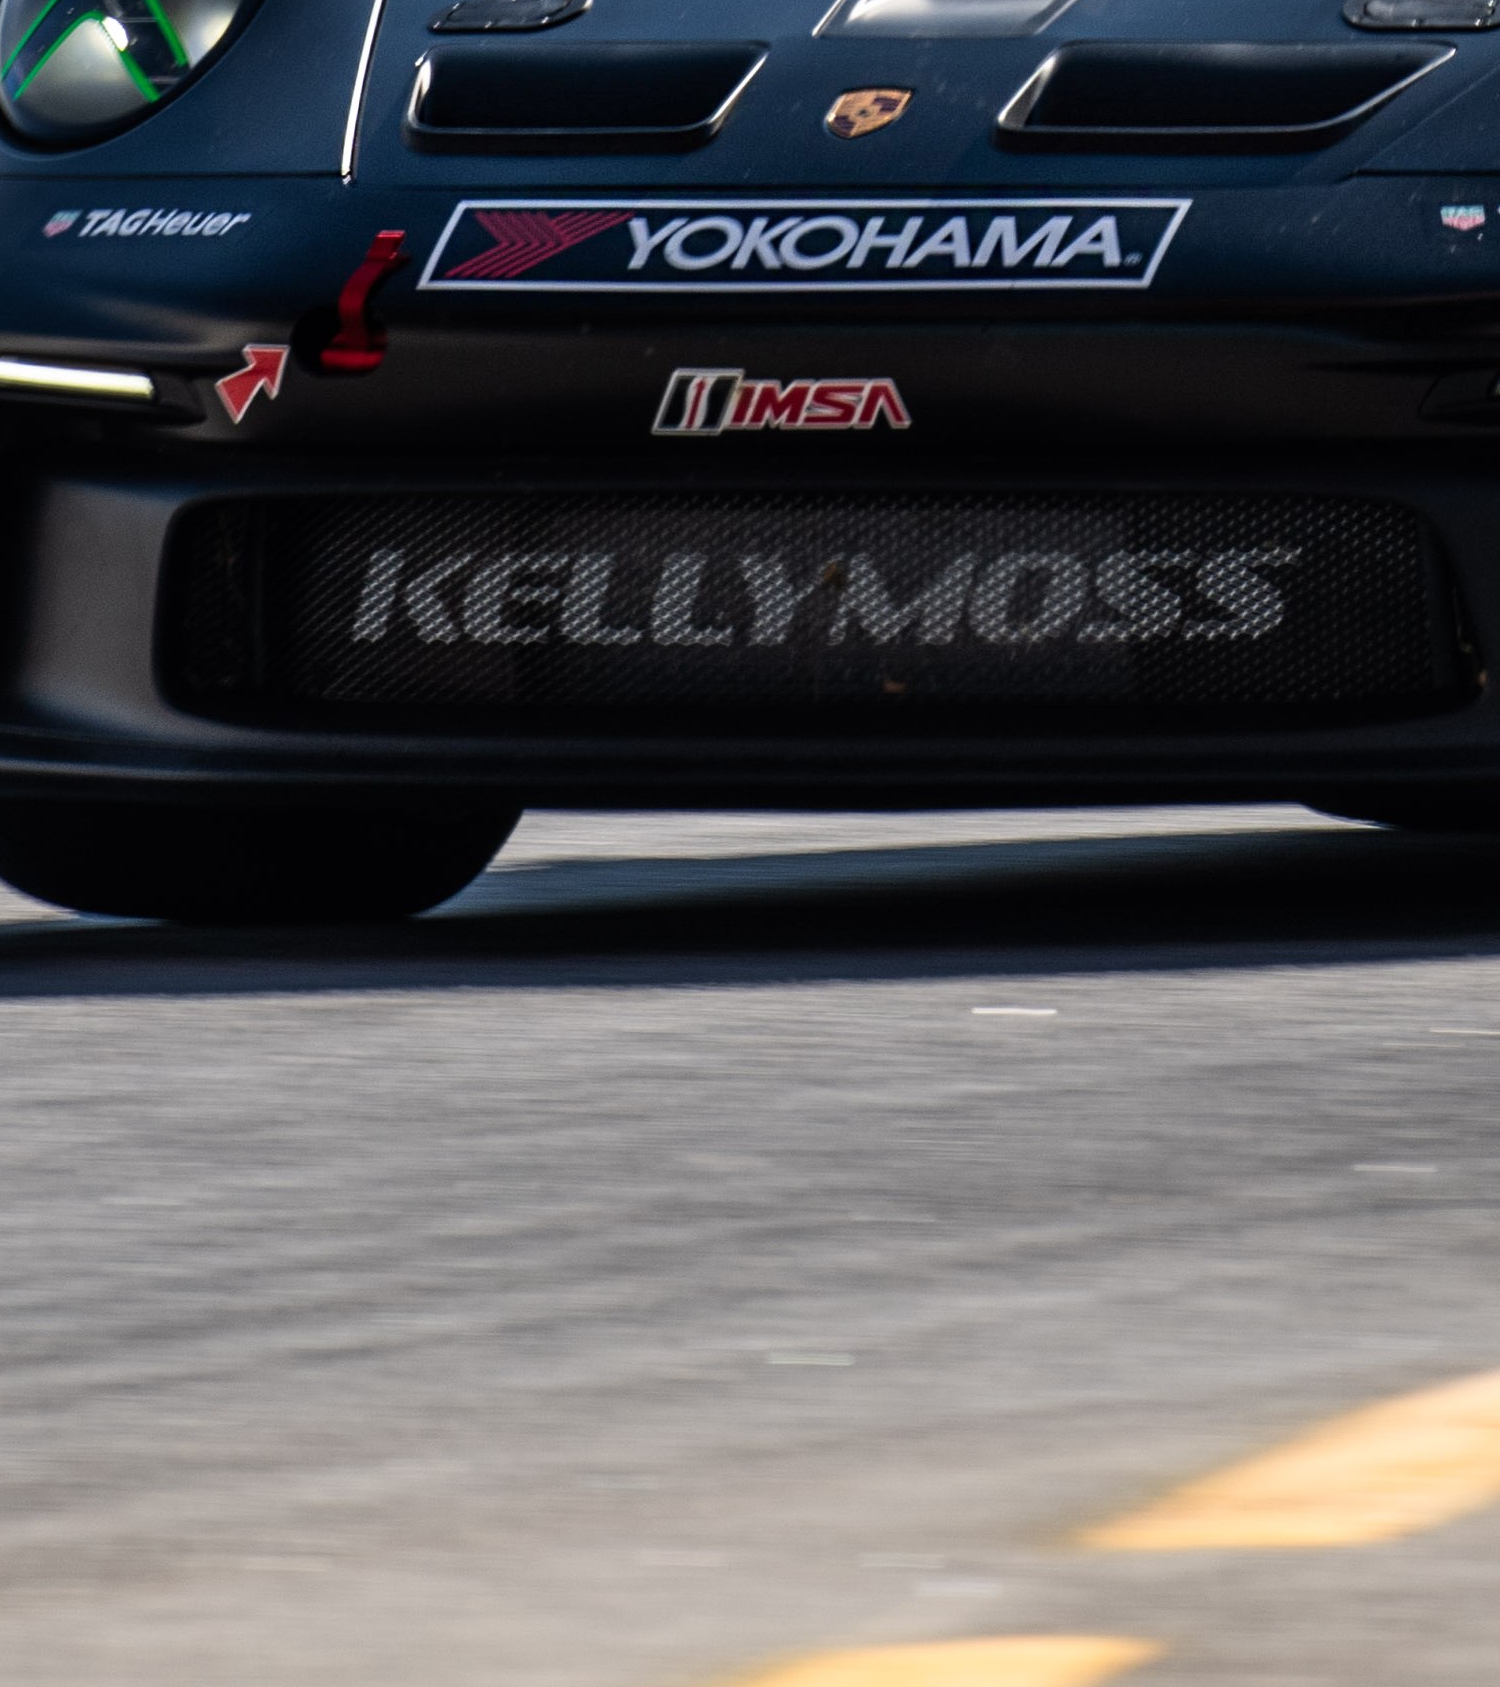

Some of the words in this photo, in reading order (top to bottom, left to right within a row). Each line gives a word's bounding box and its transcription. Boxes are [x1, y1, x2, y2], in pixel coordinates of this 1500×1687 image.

[626, 214, 1123, 269] YOKOHAMA
[728, 378, 912, 430] IMSA
[350, 545, 1302, 648] KELLYMOSS
